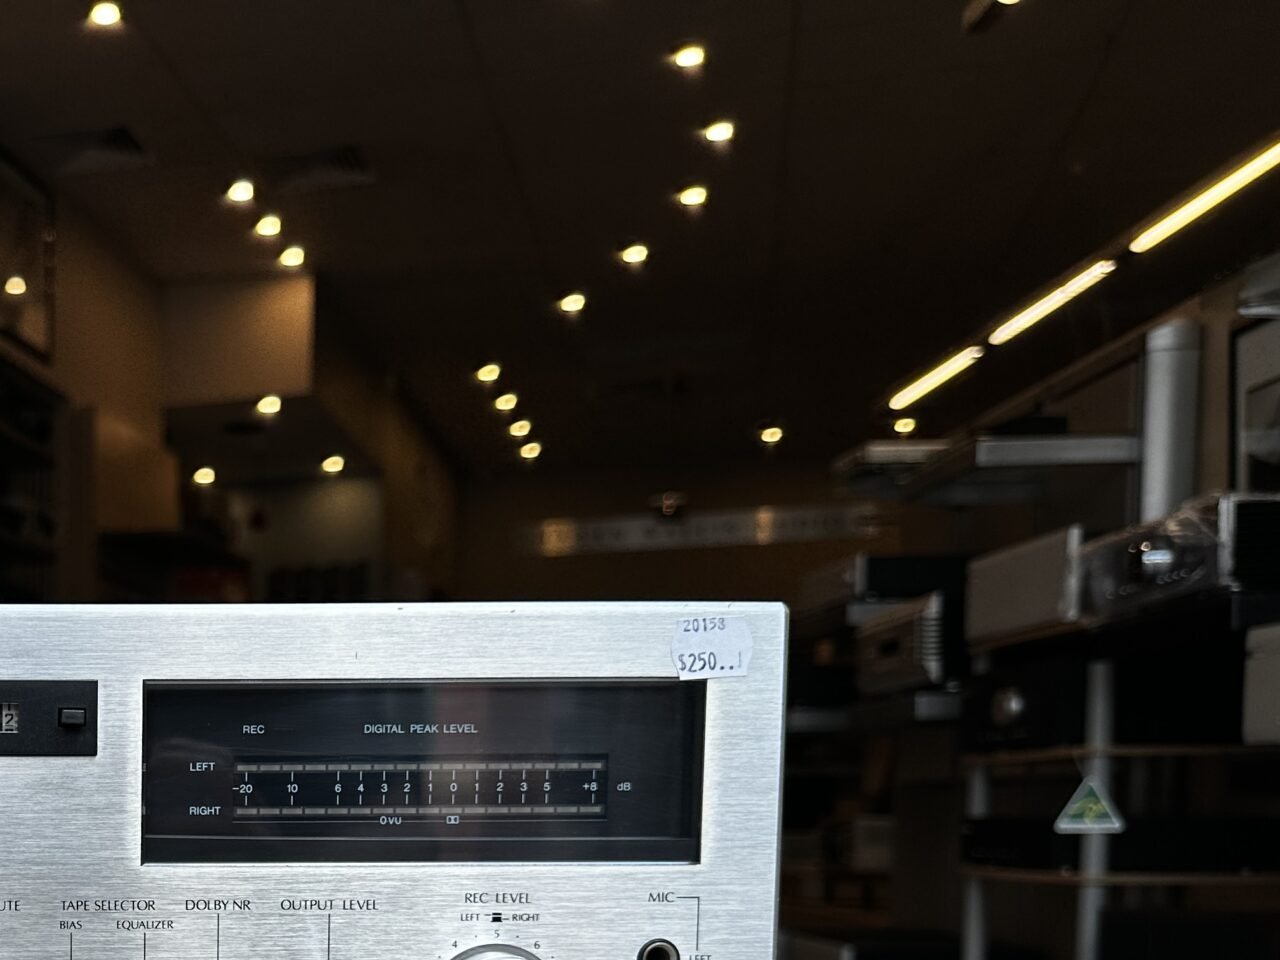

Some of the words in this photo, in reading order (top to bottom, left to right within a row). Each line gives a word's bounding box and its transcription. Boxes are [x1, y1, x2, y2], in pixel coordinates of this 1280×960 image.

[242, 724, 266, 734] REC
[364, 724, 404, 734] DIGITAL
[410, 724, 439, 734] PEAK
[442, 724, 478, 734] LEVEL
[189, 762, 216, 772] LEFT
[286, 784, 298, 794] 10
[334, 784, 342, 794] 6
[357, 784, 364, 794] 4
[380, 784, 388, 793] 3
[404, 783, 411, 793] 2
[428, 783, 432, 792] 1
[450, 783, 458, 792] 0
[474, 783, 480, 792] 1
[496, 782, 504, 792] 2
[520, 782, 528, 792] 3
[543, 782, 551, 792] 5
[582, 782, 598, 792] +8
[616, 782, 632, 792] dB
[188, 806, 221, 816] RIGHT
[464, 892, 489, 904] REC
[495, 892, 532, 904] LEVEL
[648, 892, 675, 903] MIC
[60, 900, 90, 912] TAPE
[94, 900, 156, 912] SELECTOR
[184, 899, 230, 912] DOLBY
[232, 899, 252, 912] NR
[280, 899, 335, 910] OUTPUT
[342, 899, 379, 910] LEVEL
[460, 914, 480, 922] LEFT
[512, 914, 540, 922] RIGHT
[60, 920, 82, 930] BIAS
[116, 920, 174, 931] EQUALIZER
[494, 930, 500, 938] 5
[452, 940, 458, 948] 4
[534, 940, 540, 950] 6
